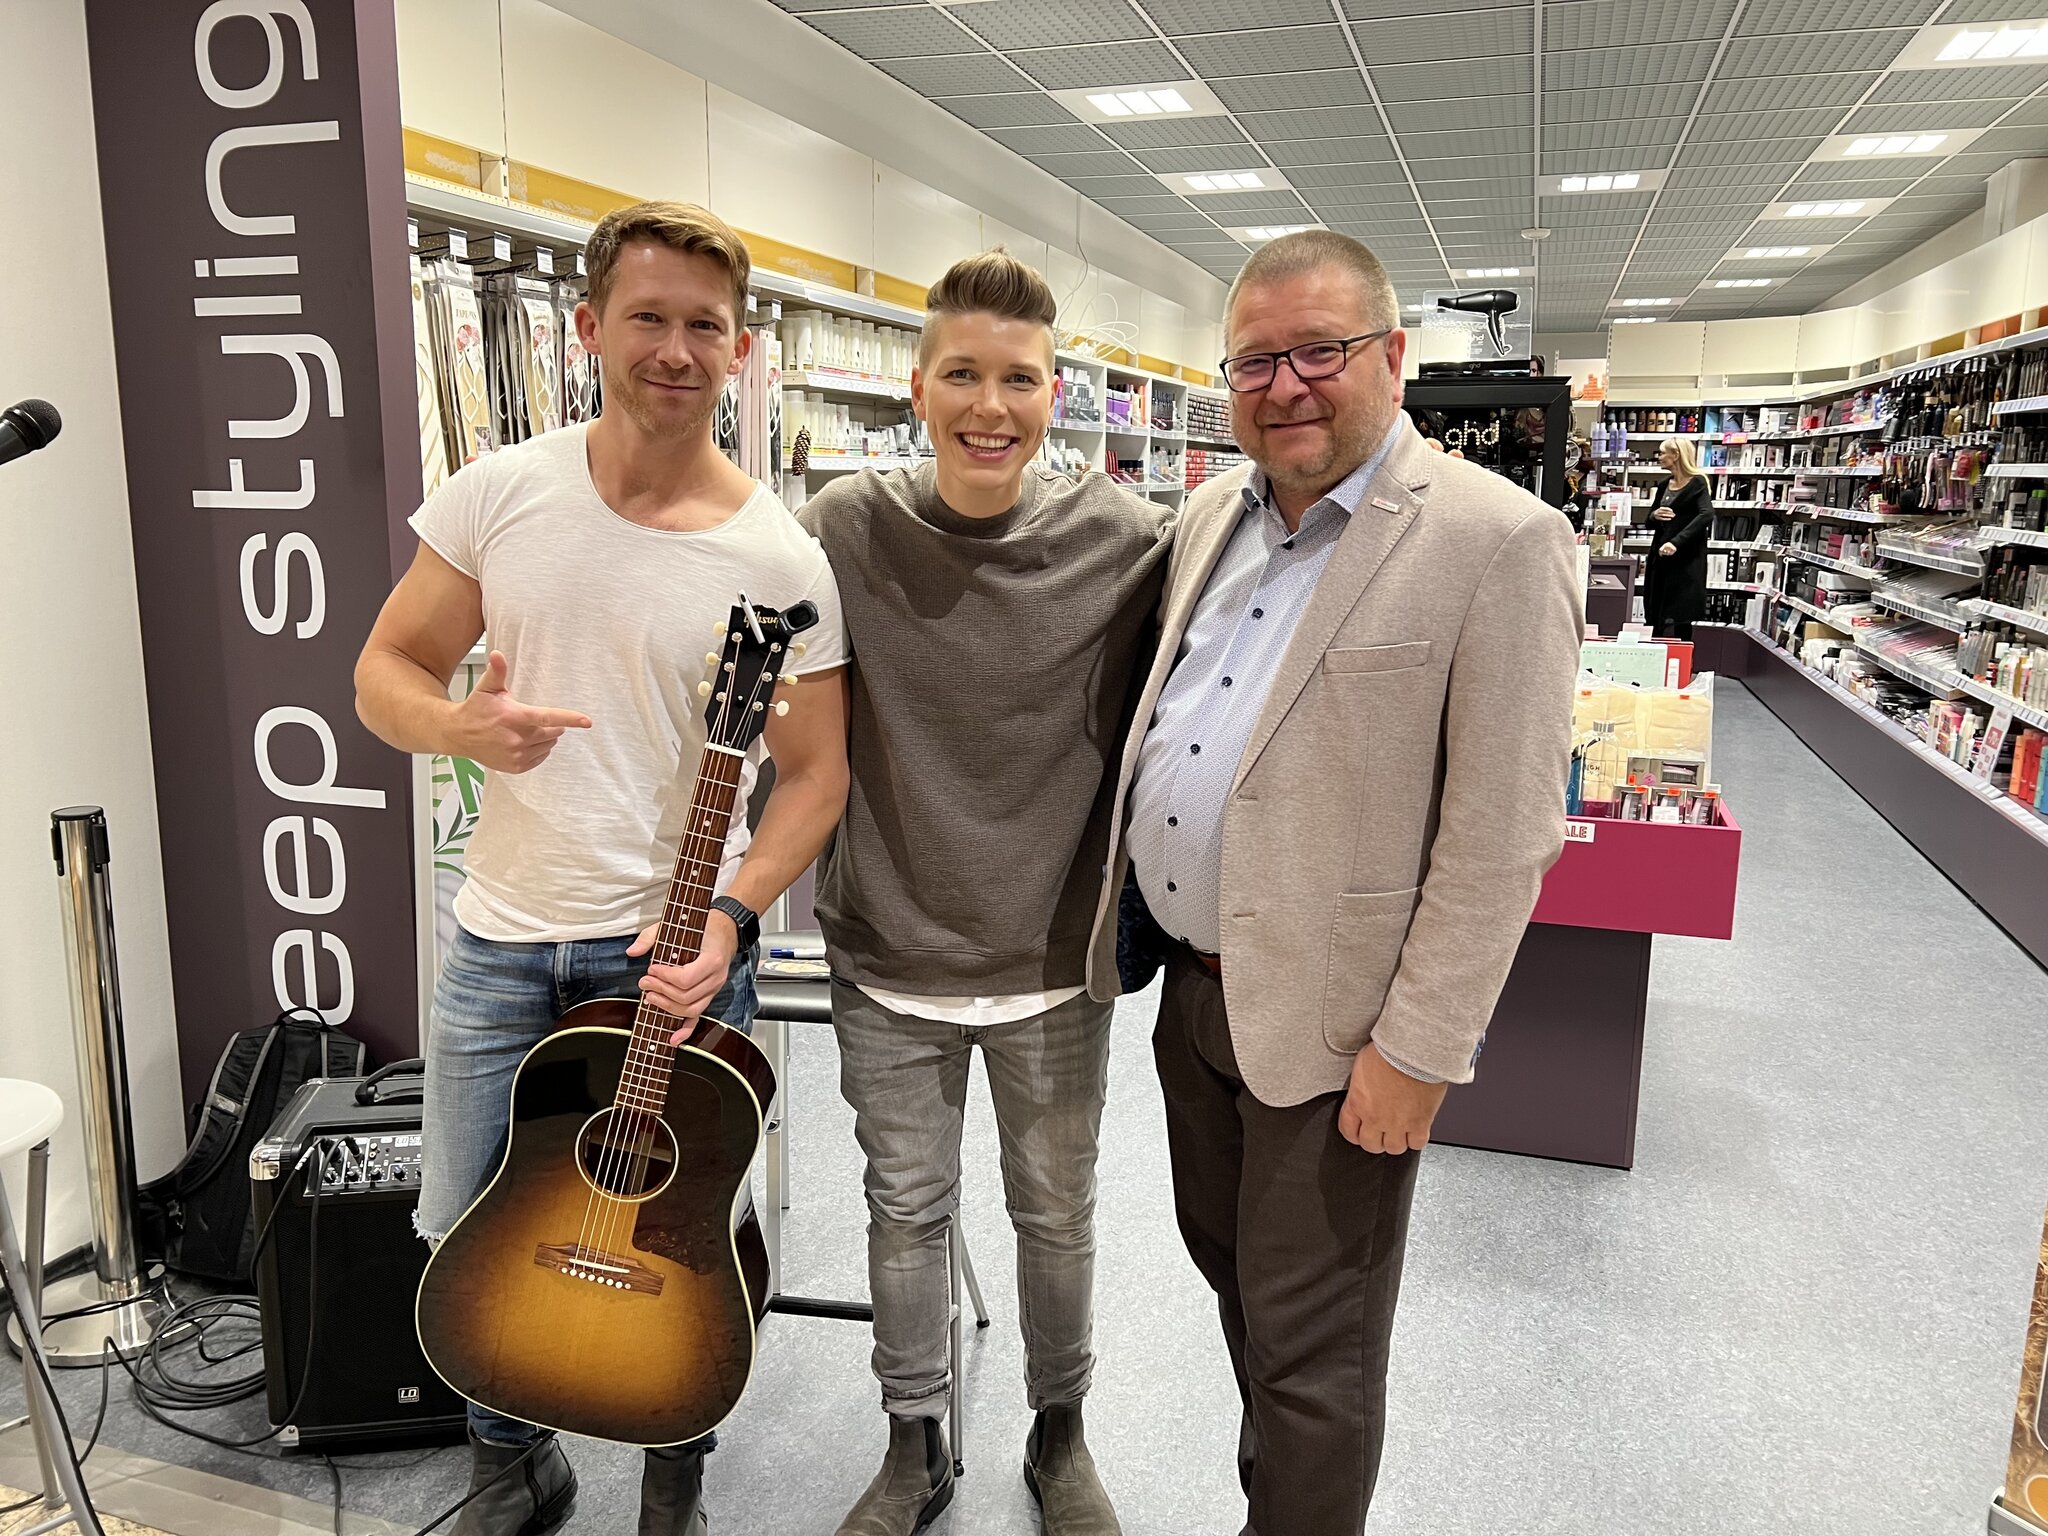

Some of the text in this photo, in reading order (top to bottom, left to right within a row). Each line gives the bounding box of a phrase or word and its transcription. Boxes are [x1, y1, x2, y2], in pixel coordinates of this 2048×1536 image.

[192, 0, 344, 639] styling
[1445, 419, 1500, 450] ghd
[400, 1388, 417, 1399] LD
